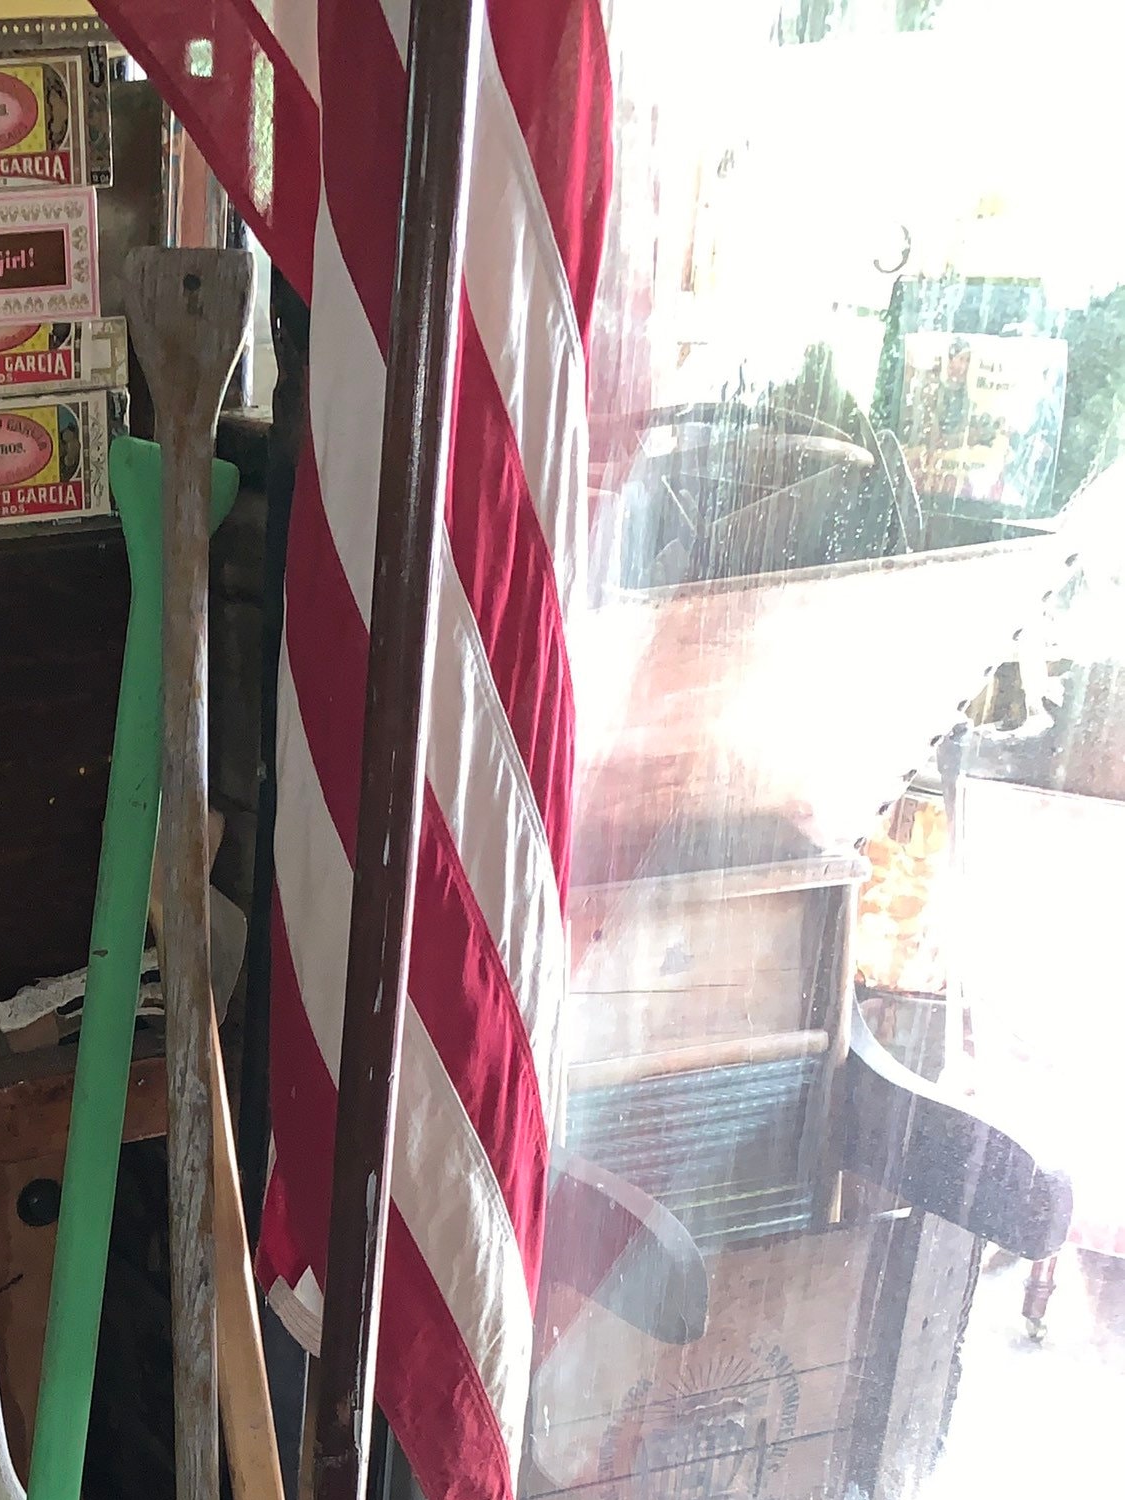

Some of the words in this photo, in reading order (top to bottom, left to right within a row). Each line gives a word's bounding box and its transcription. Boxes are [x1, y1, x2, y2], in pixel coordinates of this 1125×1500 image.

[0, 155, 66, 180] GARCIA
[5, 352, 68, 377] GARCIA
[17, 484, 77, 506] GARCIA
